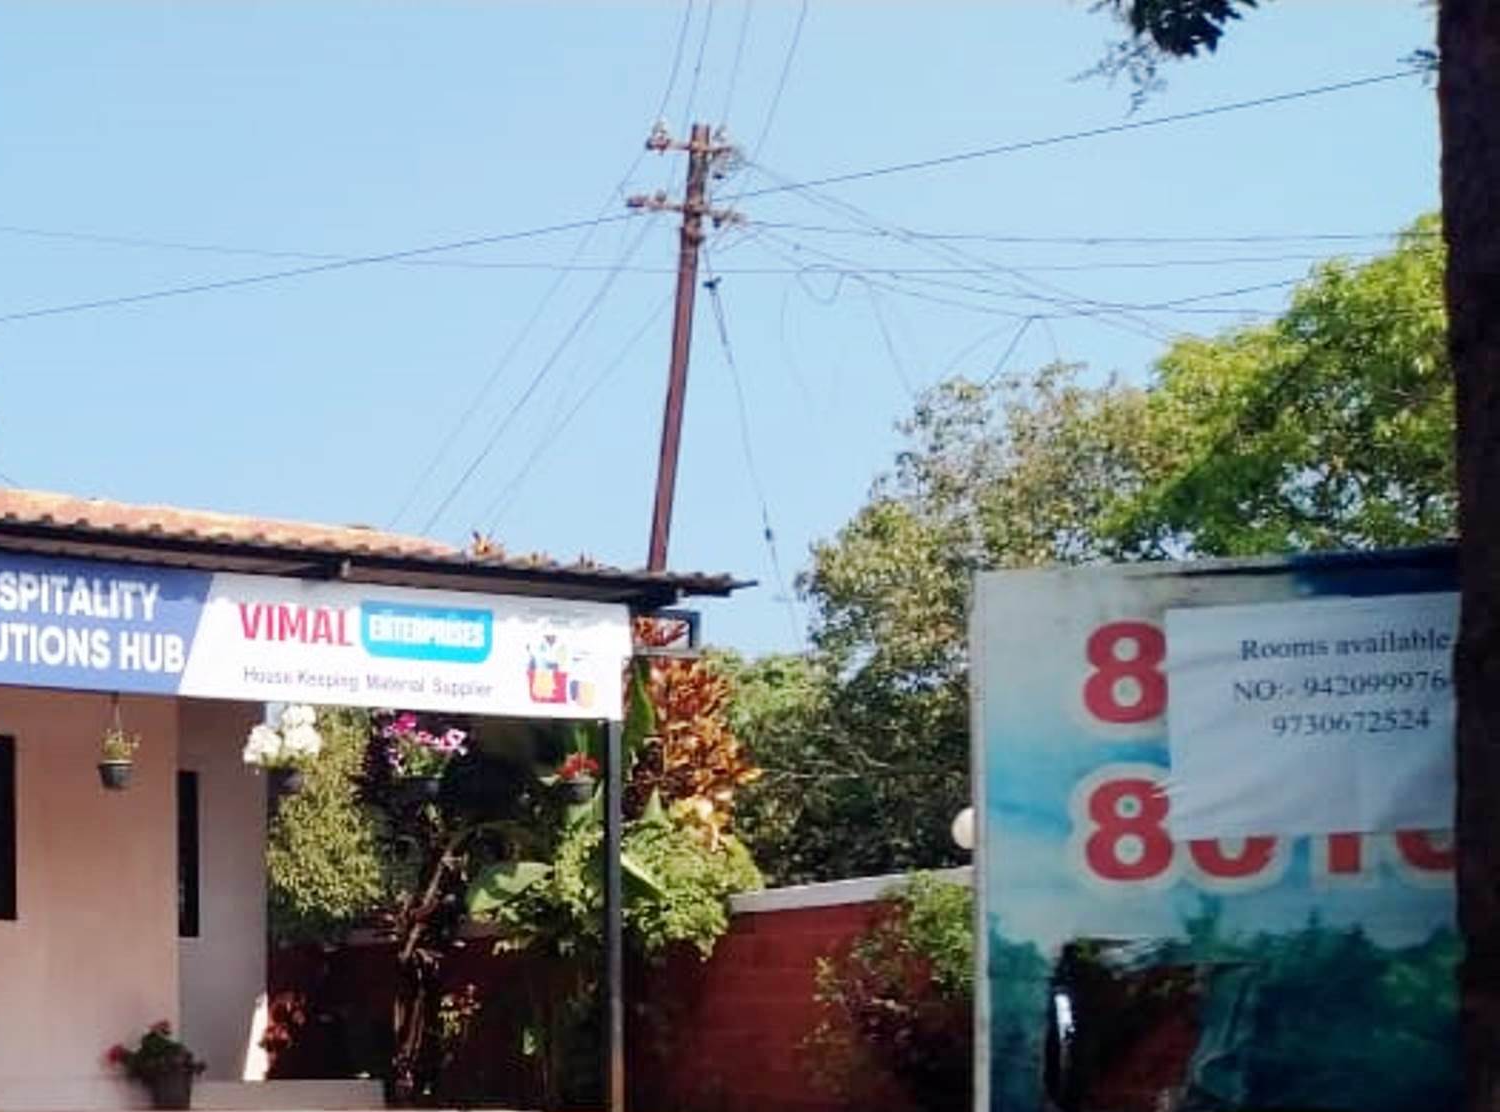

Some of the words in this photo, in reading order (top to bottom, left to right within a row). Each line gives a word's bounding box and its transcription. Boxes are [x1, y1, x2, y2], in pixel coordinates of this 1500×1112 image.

[238, 602, 354, 646] VIMAL
[369, 613, 485, 648] ENTERPRISES
[119, 631, 186, 674] HUB
[1240, 638, 1329, 660] Rooms
[1335, 627, 1453, 655] available
[244, 666, 293, 685] House
[297, 670, 359, 692] Keeping
[366, 673, 425, 693] Material
[432, 676, 495, 698] Supplier
[1302, 669, 1453, 697] 942099976
